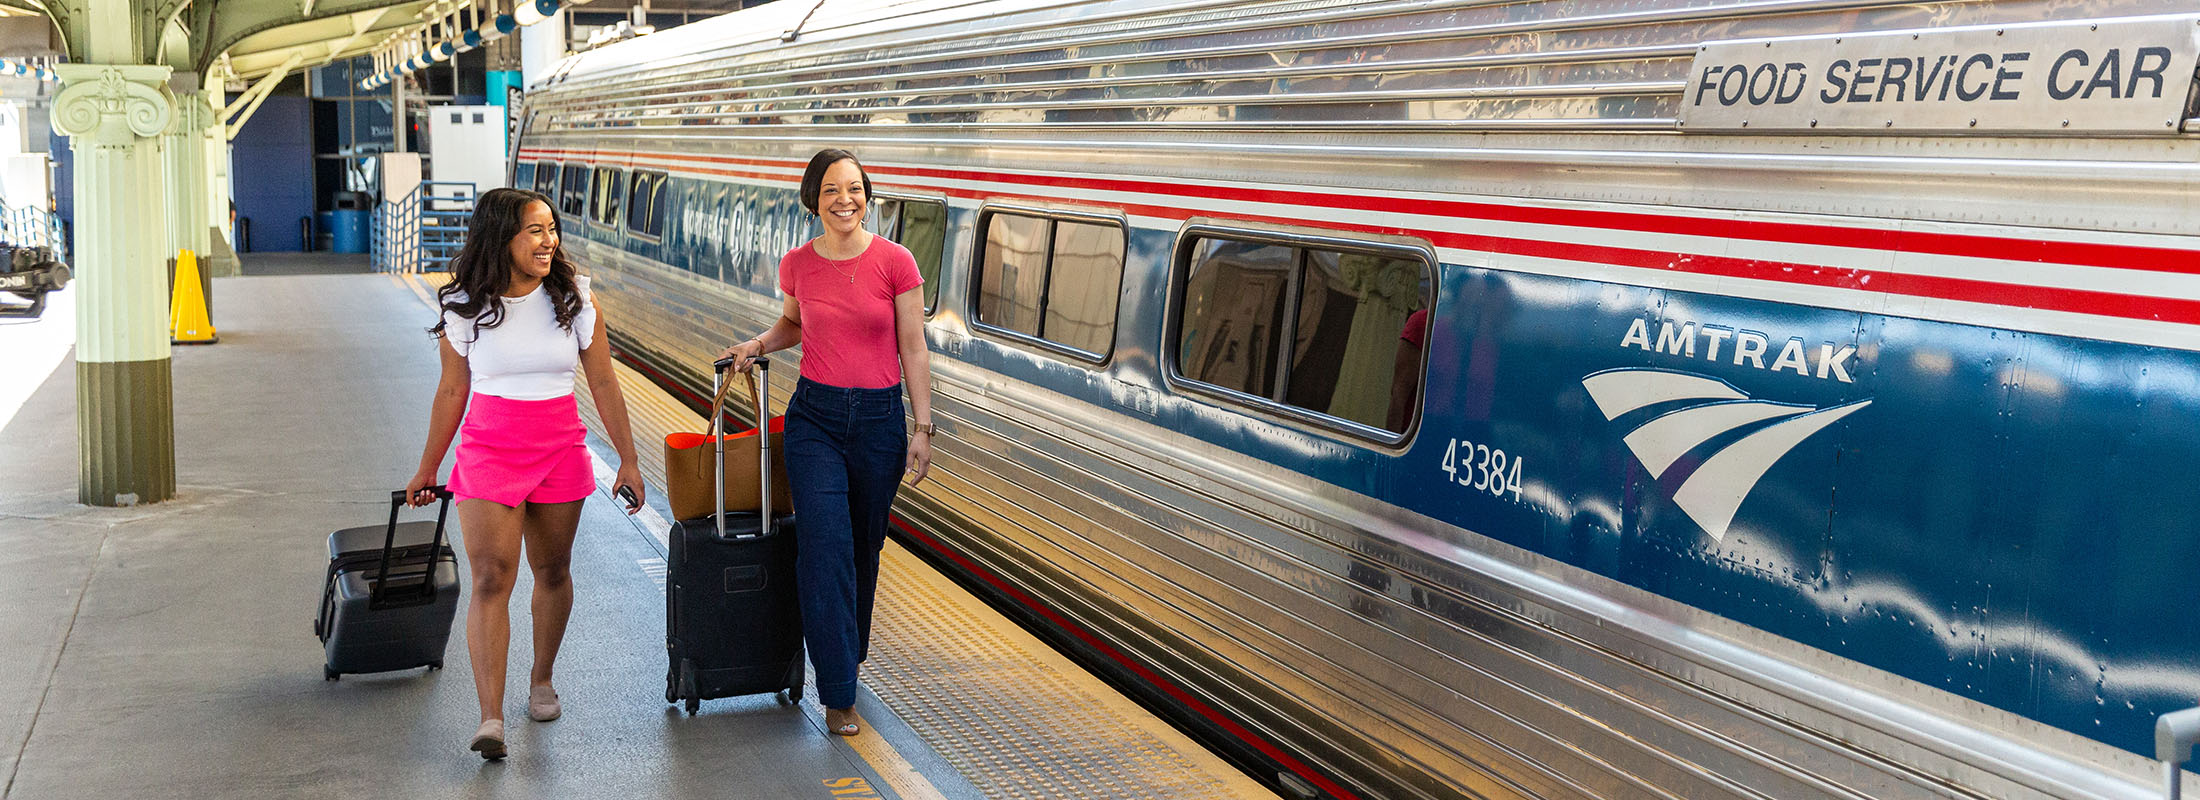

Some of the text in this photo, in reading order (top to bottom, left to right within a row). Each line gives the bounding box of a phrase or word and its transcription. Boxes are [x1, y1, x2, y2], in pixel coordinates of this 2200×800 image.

[1695, 46, 2172, 106] FOOD SERVICE CAR
[1620, 318, 1857, 384] AMTRAK
[1441, 438, 1523, 503] 43384
[822, 777, 882, 800] ST
